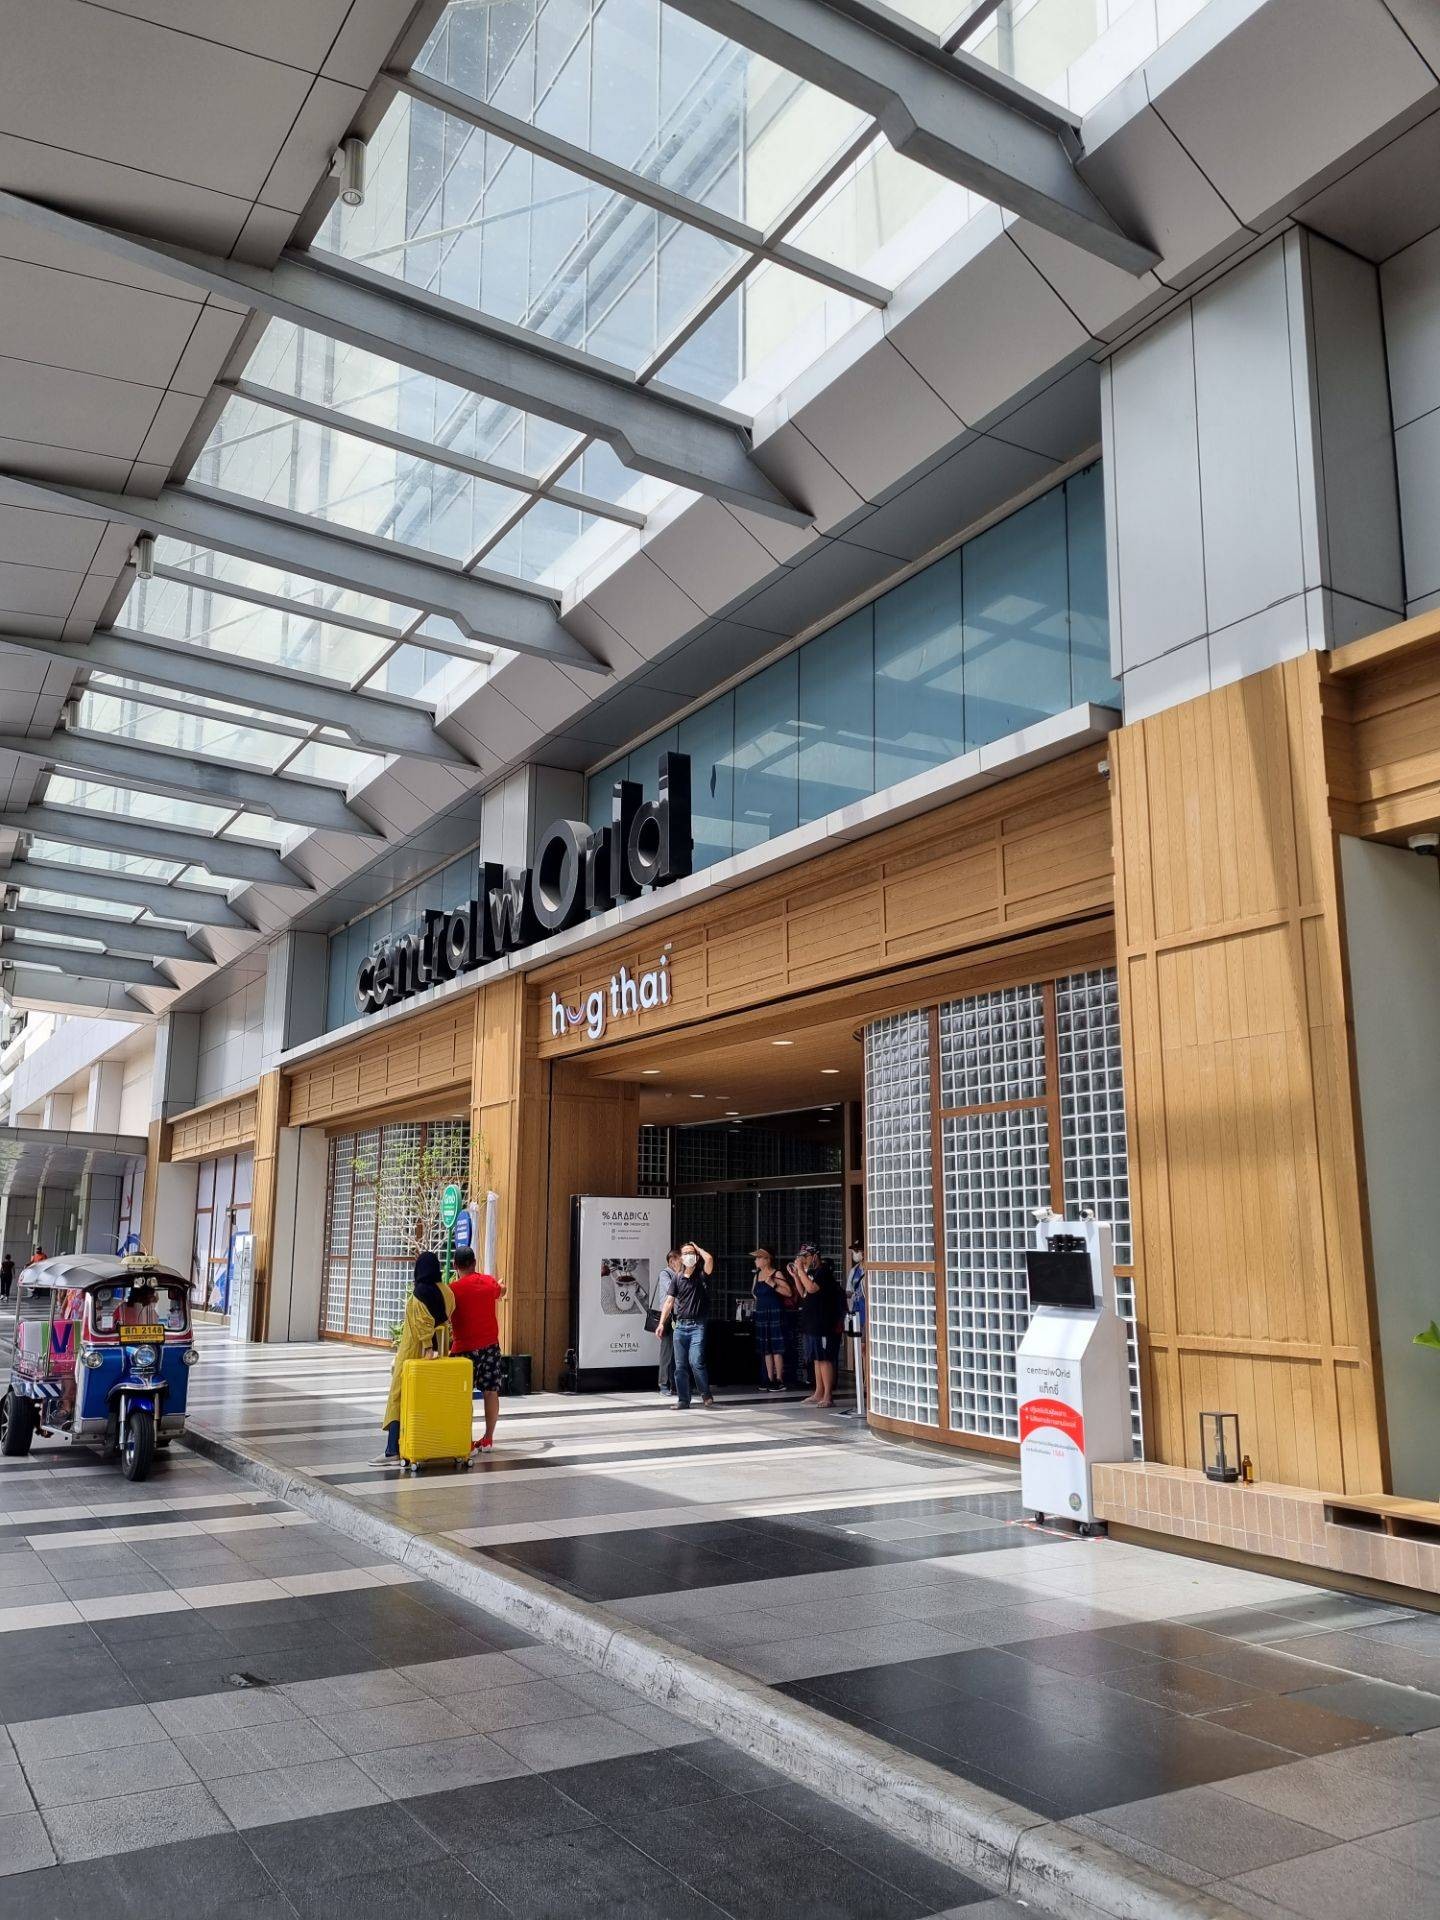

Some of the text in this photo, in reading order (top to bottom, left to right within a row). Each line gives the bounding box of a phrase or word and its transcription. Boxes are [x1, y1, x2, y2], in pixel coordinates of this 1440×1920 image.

[551, 954, 672, 1040] hug thai
[1026, 1367, 1071, 1379] centralwOrld
